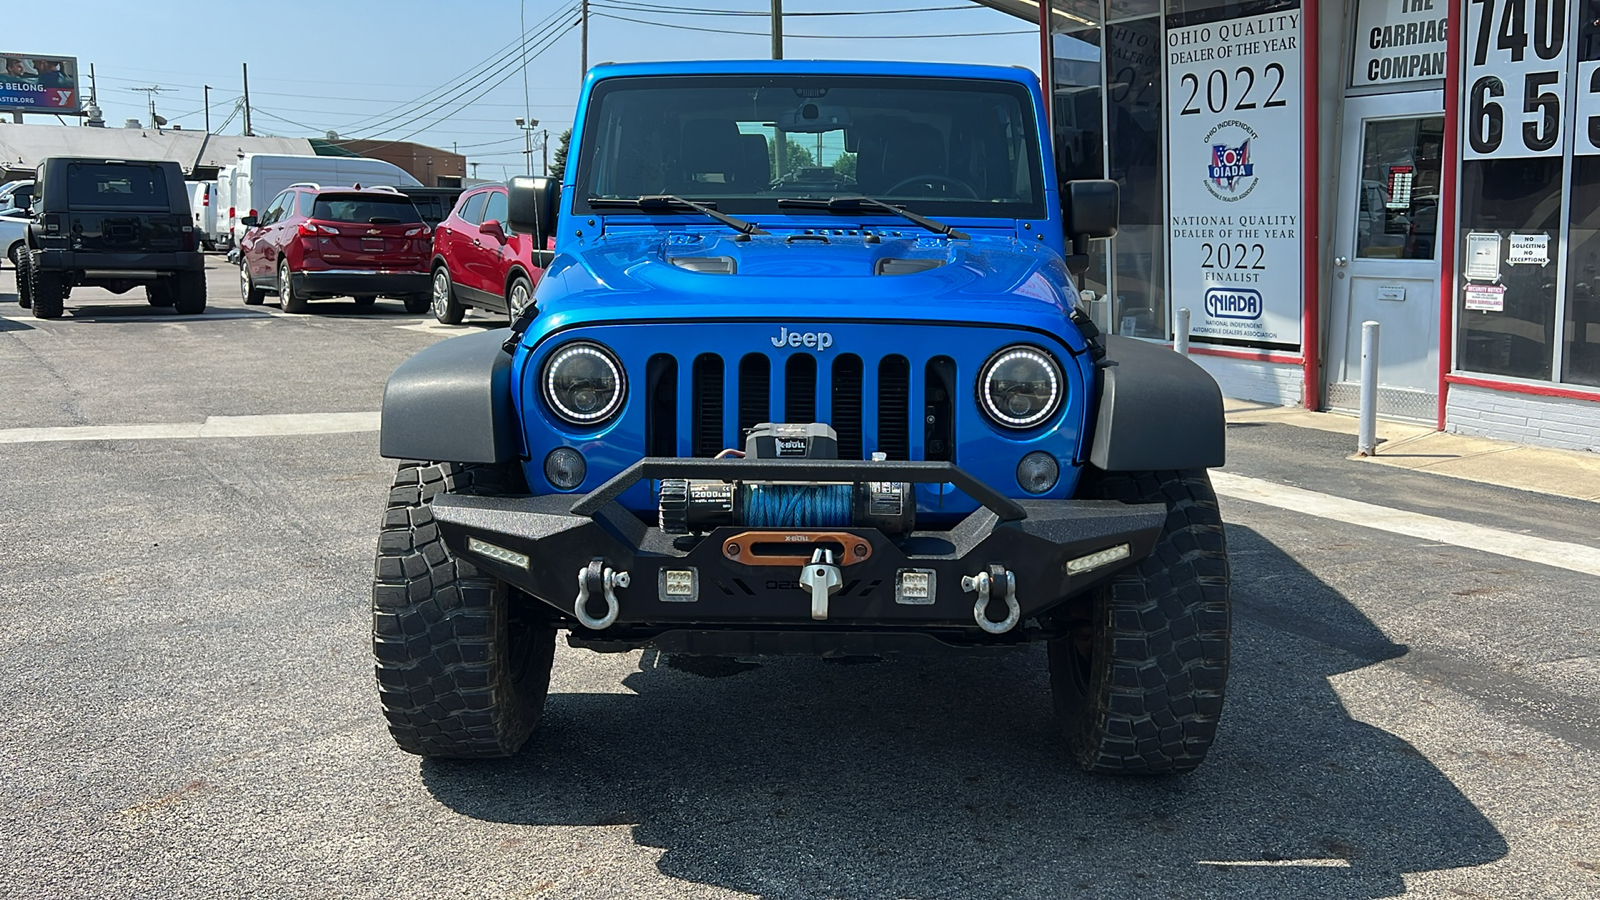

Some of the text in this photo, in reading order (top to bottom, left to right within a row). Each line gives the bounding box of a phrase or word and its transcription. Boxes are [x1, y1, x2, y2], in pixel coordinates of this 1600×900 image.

[1169, 28, 1211, 47] OHIO
[1219, 14, 1299, 42] QUALITY
[1370, 18, 1448, 50] CARRIAG
[1472, 0, 1565, 66] 740
[1171, 49, 1214, 65] DEALER
[1217, 45, 1233, 59] OF
[1236, 41, 1260, 56] THE
[1263, 36, 1297, 52] YEAR
[1368, 52, 1447, 82] COMPAN
[6, 82, 47, 92] BELONG.
[1180, 62, 1287, 116] 2022
[1204, 120, 1258, 143] OHIO INDEPENDENT
[1214, 165, 1246, 177] OIADA
[1172, 215, 1297, 227] NATIONAL QUALITY
[1174, 229, 1295, 238] DEALER OF THE YEAR
[1201, 243, 1266, 270] 2022
[1205, 272, 1260, 283] FINALIST
[1209, 294, 1257, 314] NIADA
[1230, 321, 1263, 329] INDEPENDENT
[1244, 330, 1277, 338] ASSOCIATION
[771, 326, 833, 351] Jeep
